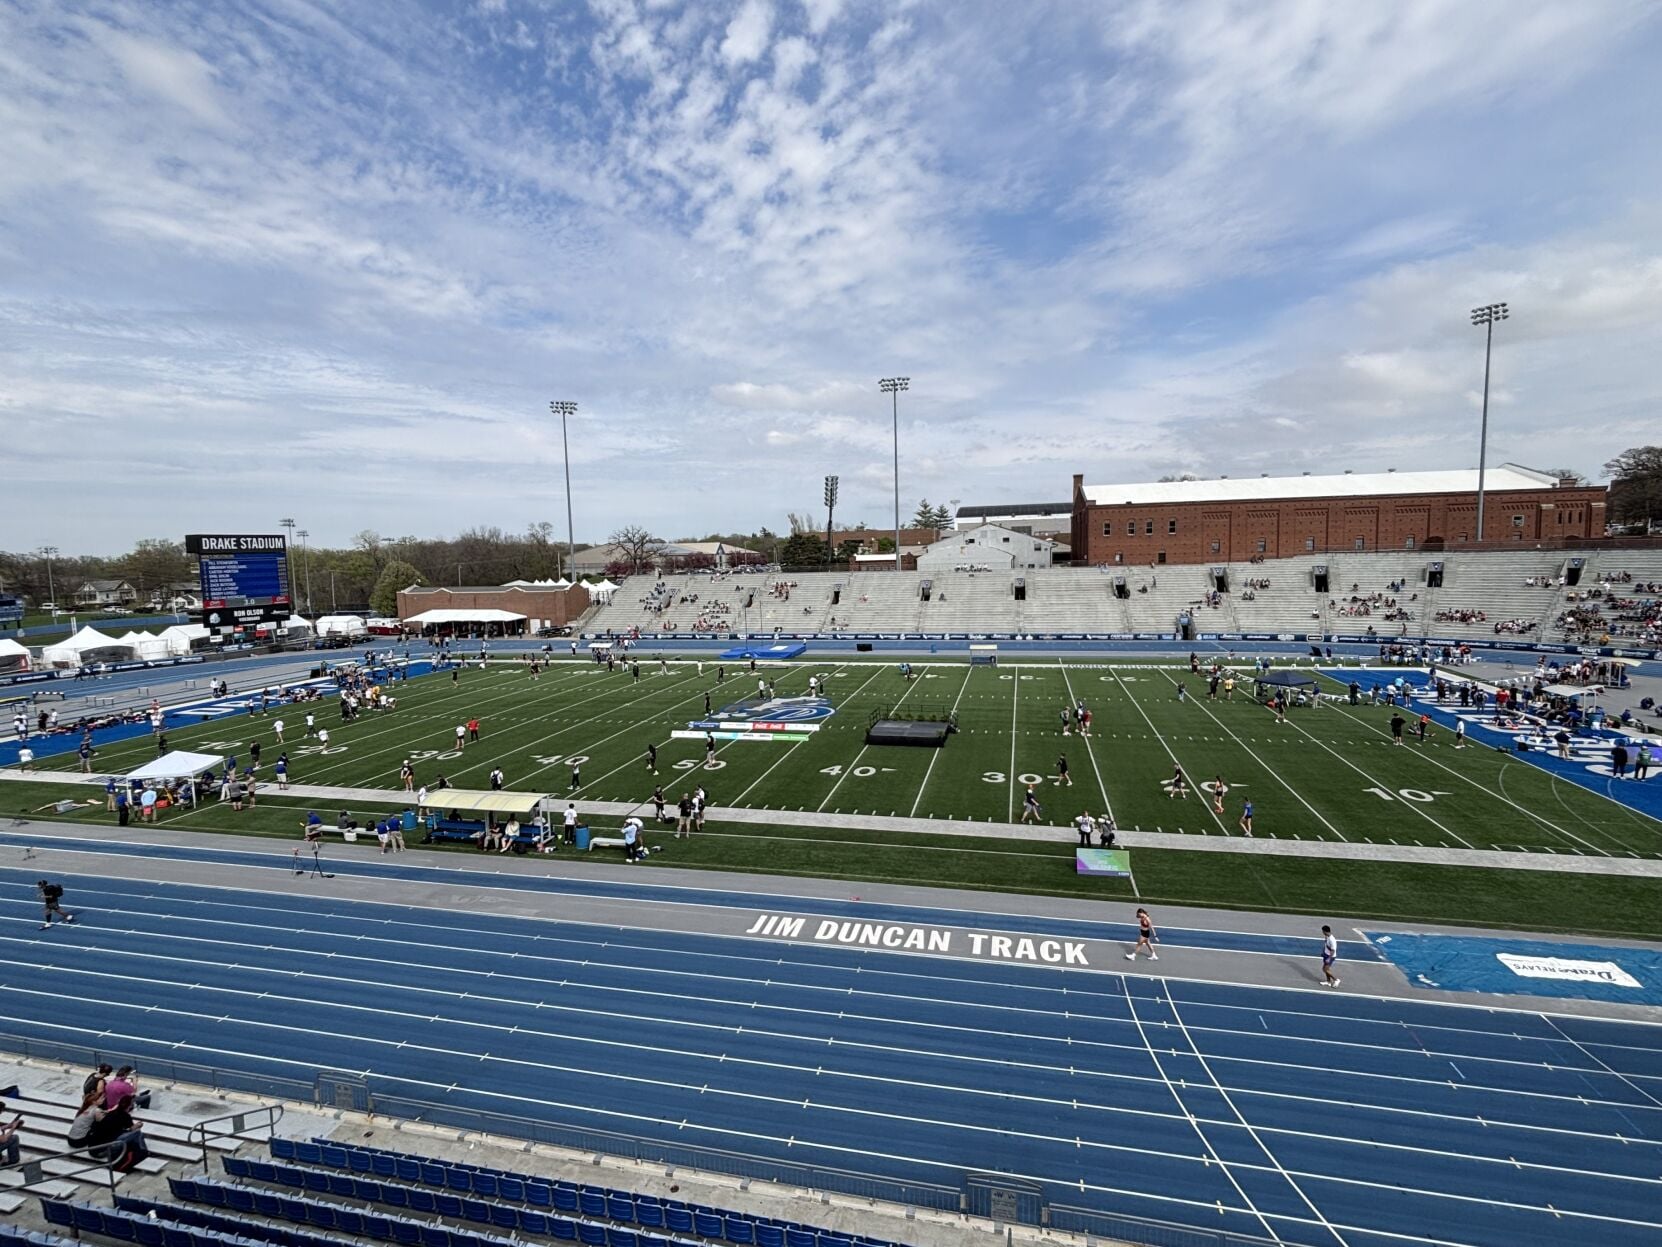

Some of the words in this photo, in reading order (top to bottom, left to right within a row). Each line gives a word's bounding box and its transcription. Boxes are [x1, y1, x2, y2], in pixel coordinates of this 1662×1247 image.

[202, 537, 238, 549] DRAKE
[240, 537, 284, 549] STADIUM
[1576, 646, 1601, 654] Smart
[410, 750, 463, 760] 30
[536, 755, 590, 765] 40
[671, 759, 727, 771] 50
[819, 764, 877, 777] 40
[981, 771, 1043, 785] 30
[1361, 787, 1434, 802] 10
[746, 914, 806, 937] JIM
[814, 920, 951, 952] DUNCAN
[968, 933, 1089, 965] TRACK
[1513, 963, 1556, 973] RELAYS
[1558, 967, 1617, 982] Drake
